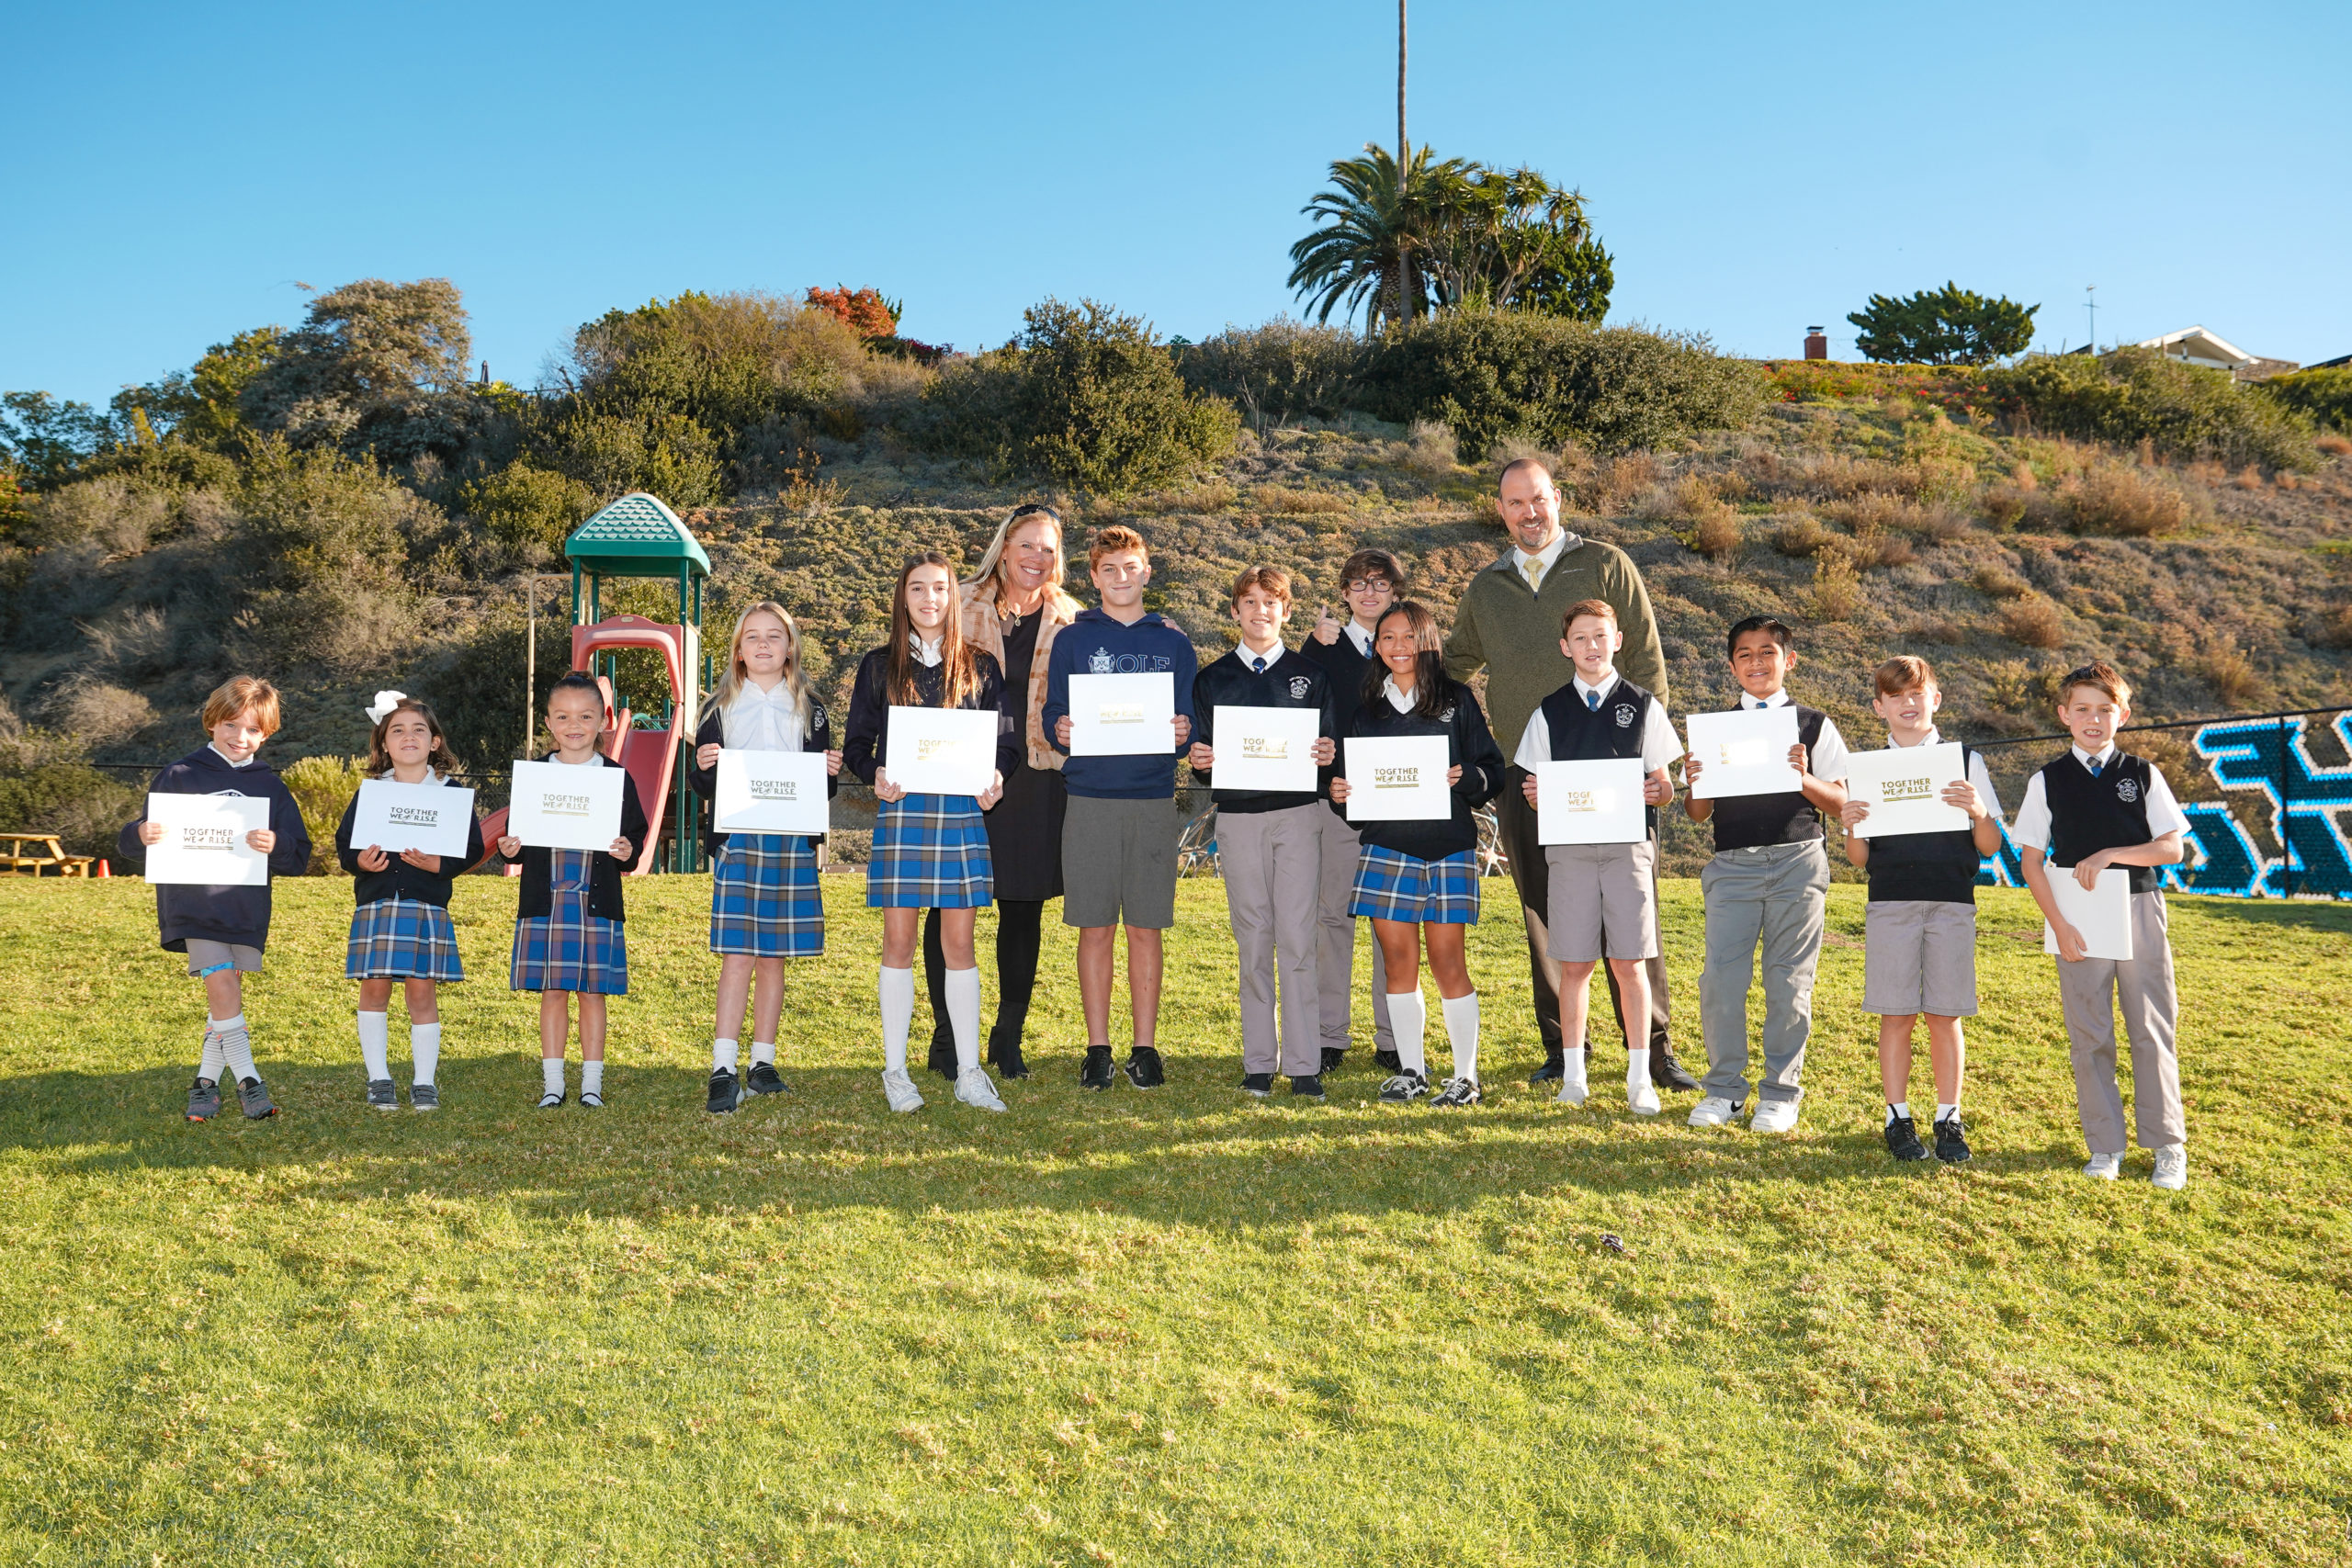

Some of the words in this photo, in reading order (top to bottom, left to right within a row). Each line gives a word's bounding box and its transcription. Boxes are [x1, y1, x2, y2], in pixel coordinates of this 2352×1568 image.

[1116, 653, 1170, 672] OLF
[751, 780, 797, 788] TOGETHER
[1882, 777, 1931, 789] TOGETHER
[751, 786, 763, 795] WE
[543, 794, 590, 804] TOGETHER
[1568, 798, 1580, 807] WE
[542, 800, 556, 808] WE
[390, 807, 438, 817] TOGETHER
[390, 812, 403, 820] WE
[184, 828, 233, 836] TOGETHER
